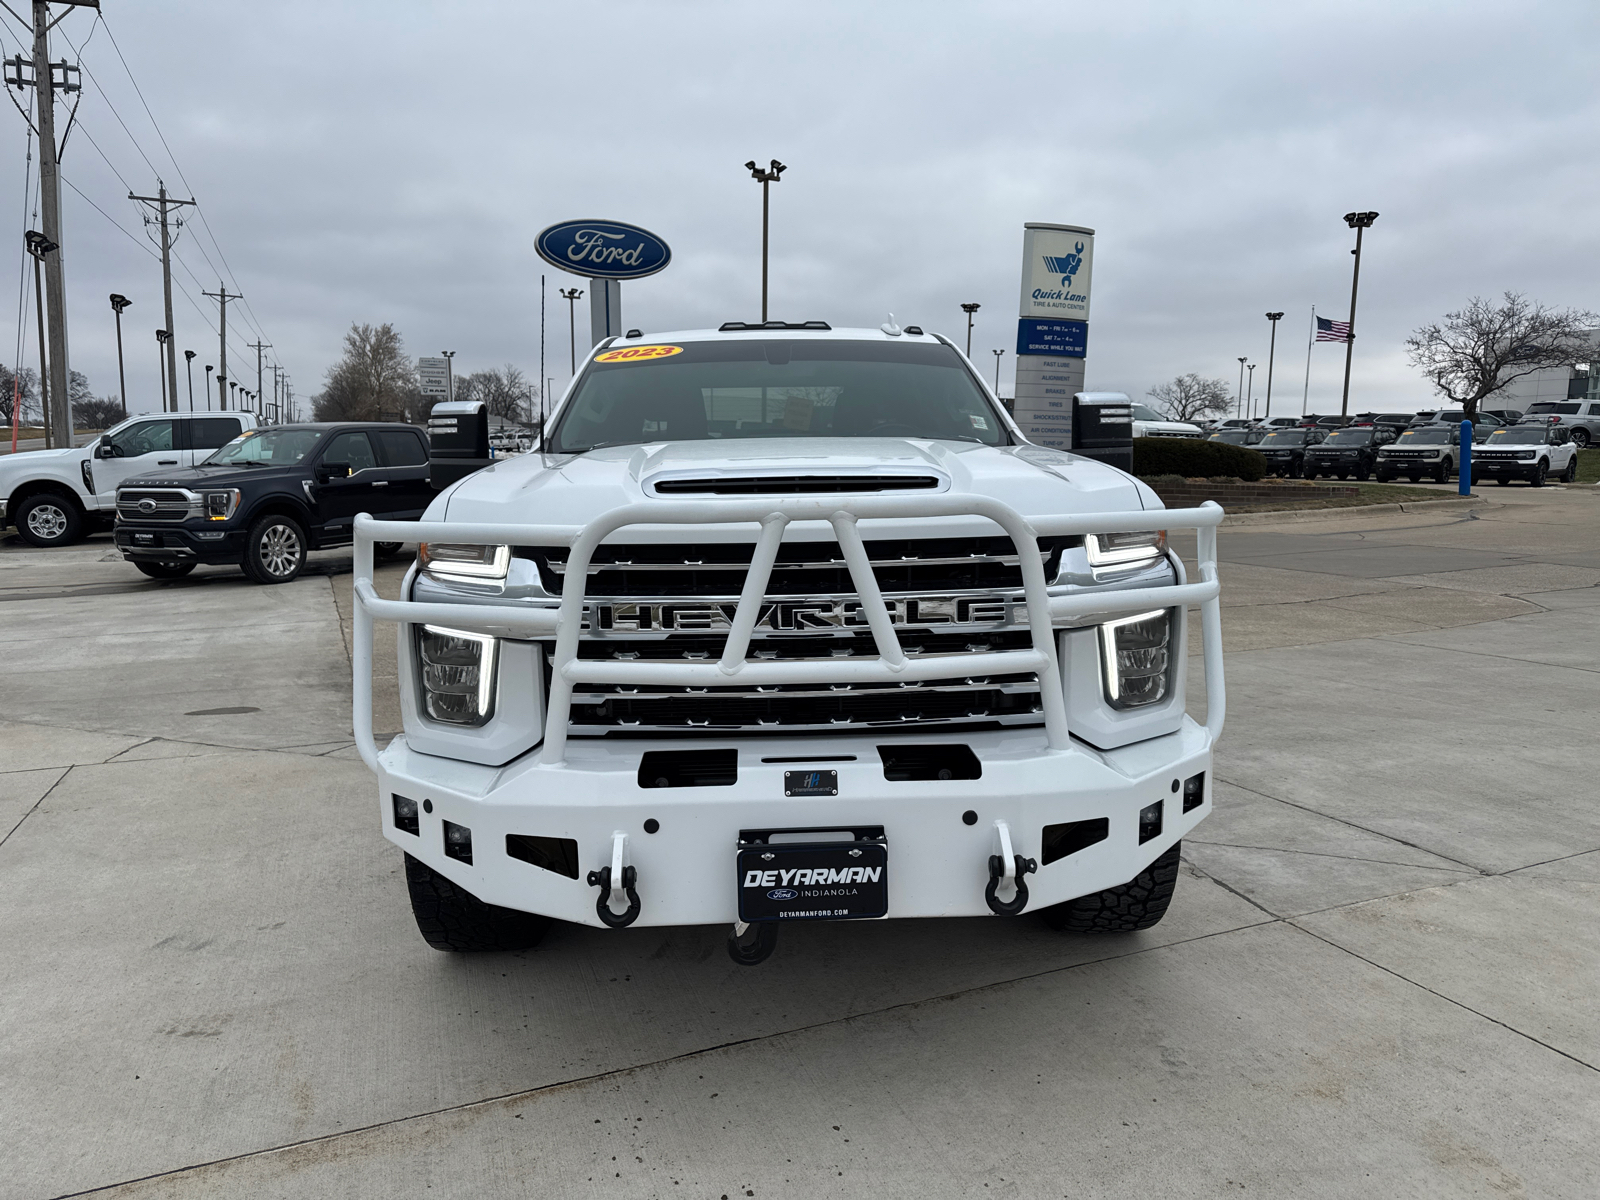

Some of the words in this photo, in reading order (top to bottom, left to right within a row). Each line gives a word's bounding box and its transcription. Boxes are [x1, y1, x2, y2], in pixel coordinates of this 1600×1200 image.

[567, 229, 645, 266] Ford
[1032, 288, 1063, 300] Quick
[1063, 290, 1087, 303] Lane
[1067, 303, 1085, 311] CENTER
[602, 347, 675, 361] 2023
[580, 596, 1028, 631] HEVROLE
[743, 866, 882, 888] DEYARMAN
[772, 889, 793, 899] Ford
[801, 888, 858, 897] INDIANOLA
[779, 908, 849, 918] DEYARMANFORD.COM
